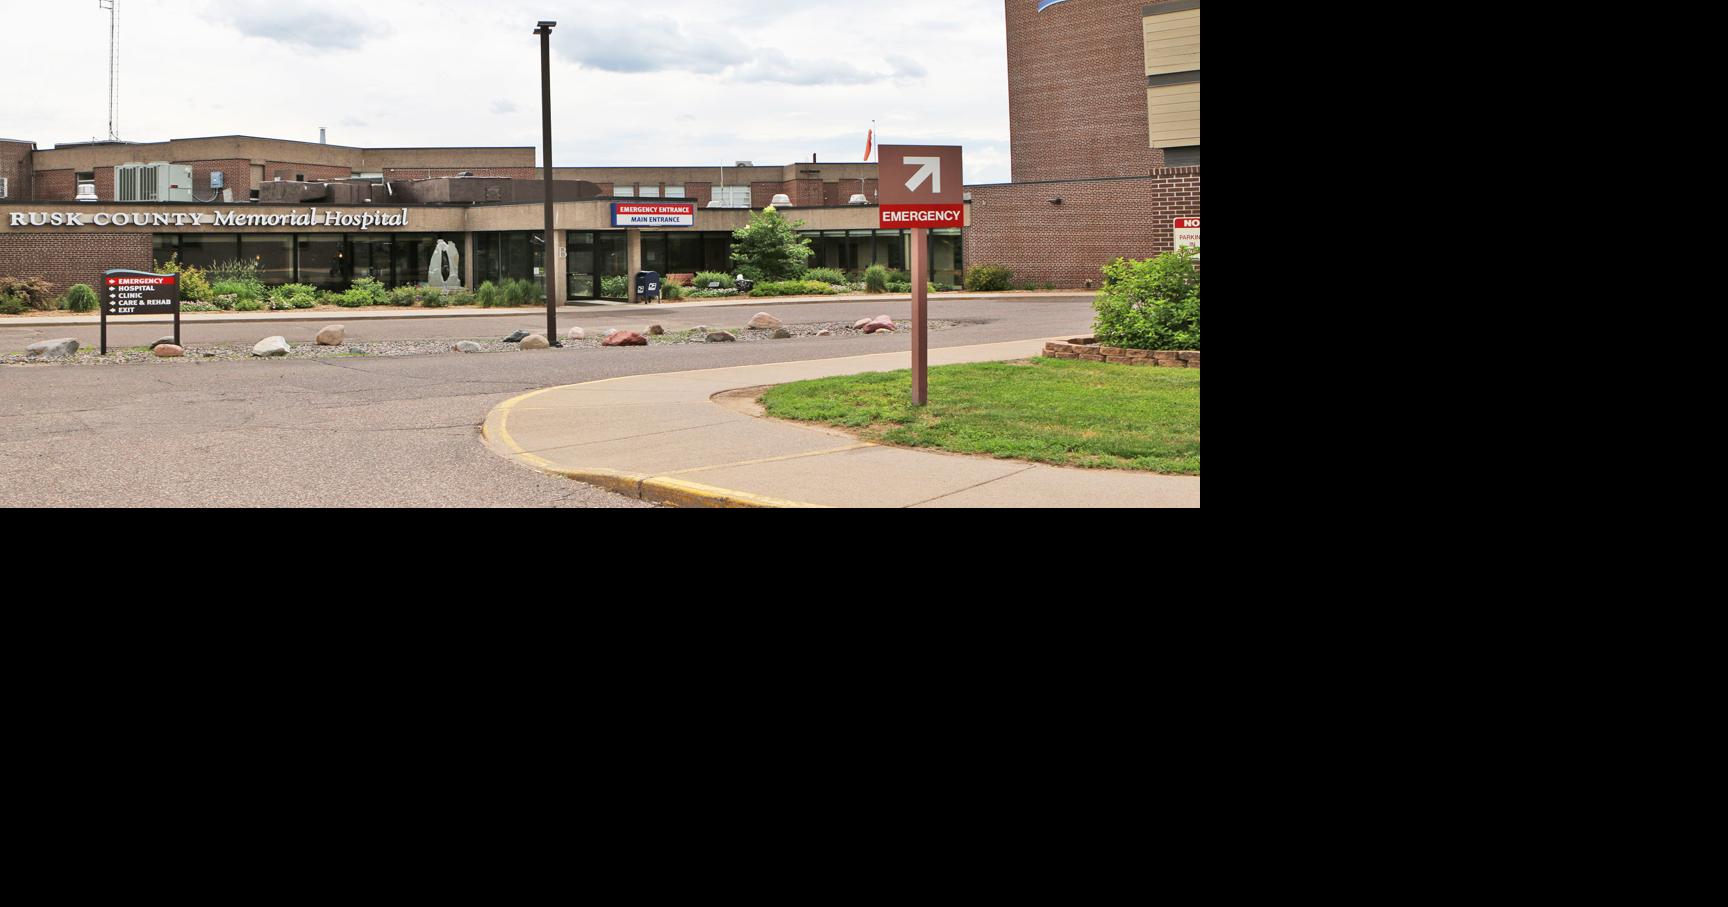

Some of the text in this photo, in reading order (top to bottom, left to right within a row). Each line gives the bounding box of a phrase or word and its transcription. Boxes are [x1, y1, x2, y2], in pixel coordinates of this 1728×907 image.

[10, 207, 409, 230] RUSK COUNTY Memorial Hospital
[882, 210, 961, 222] EMERGENCY
[1184, 219, 1200, 227] NO
